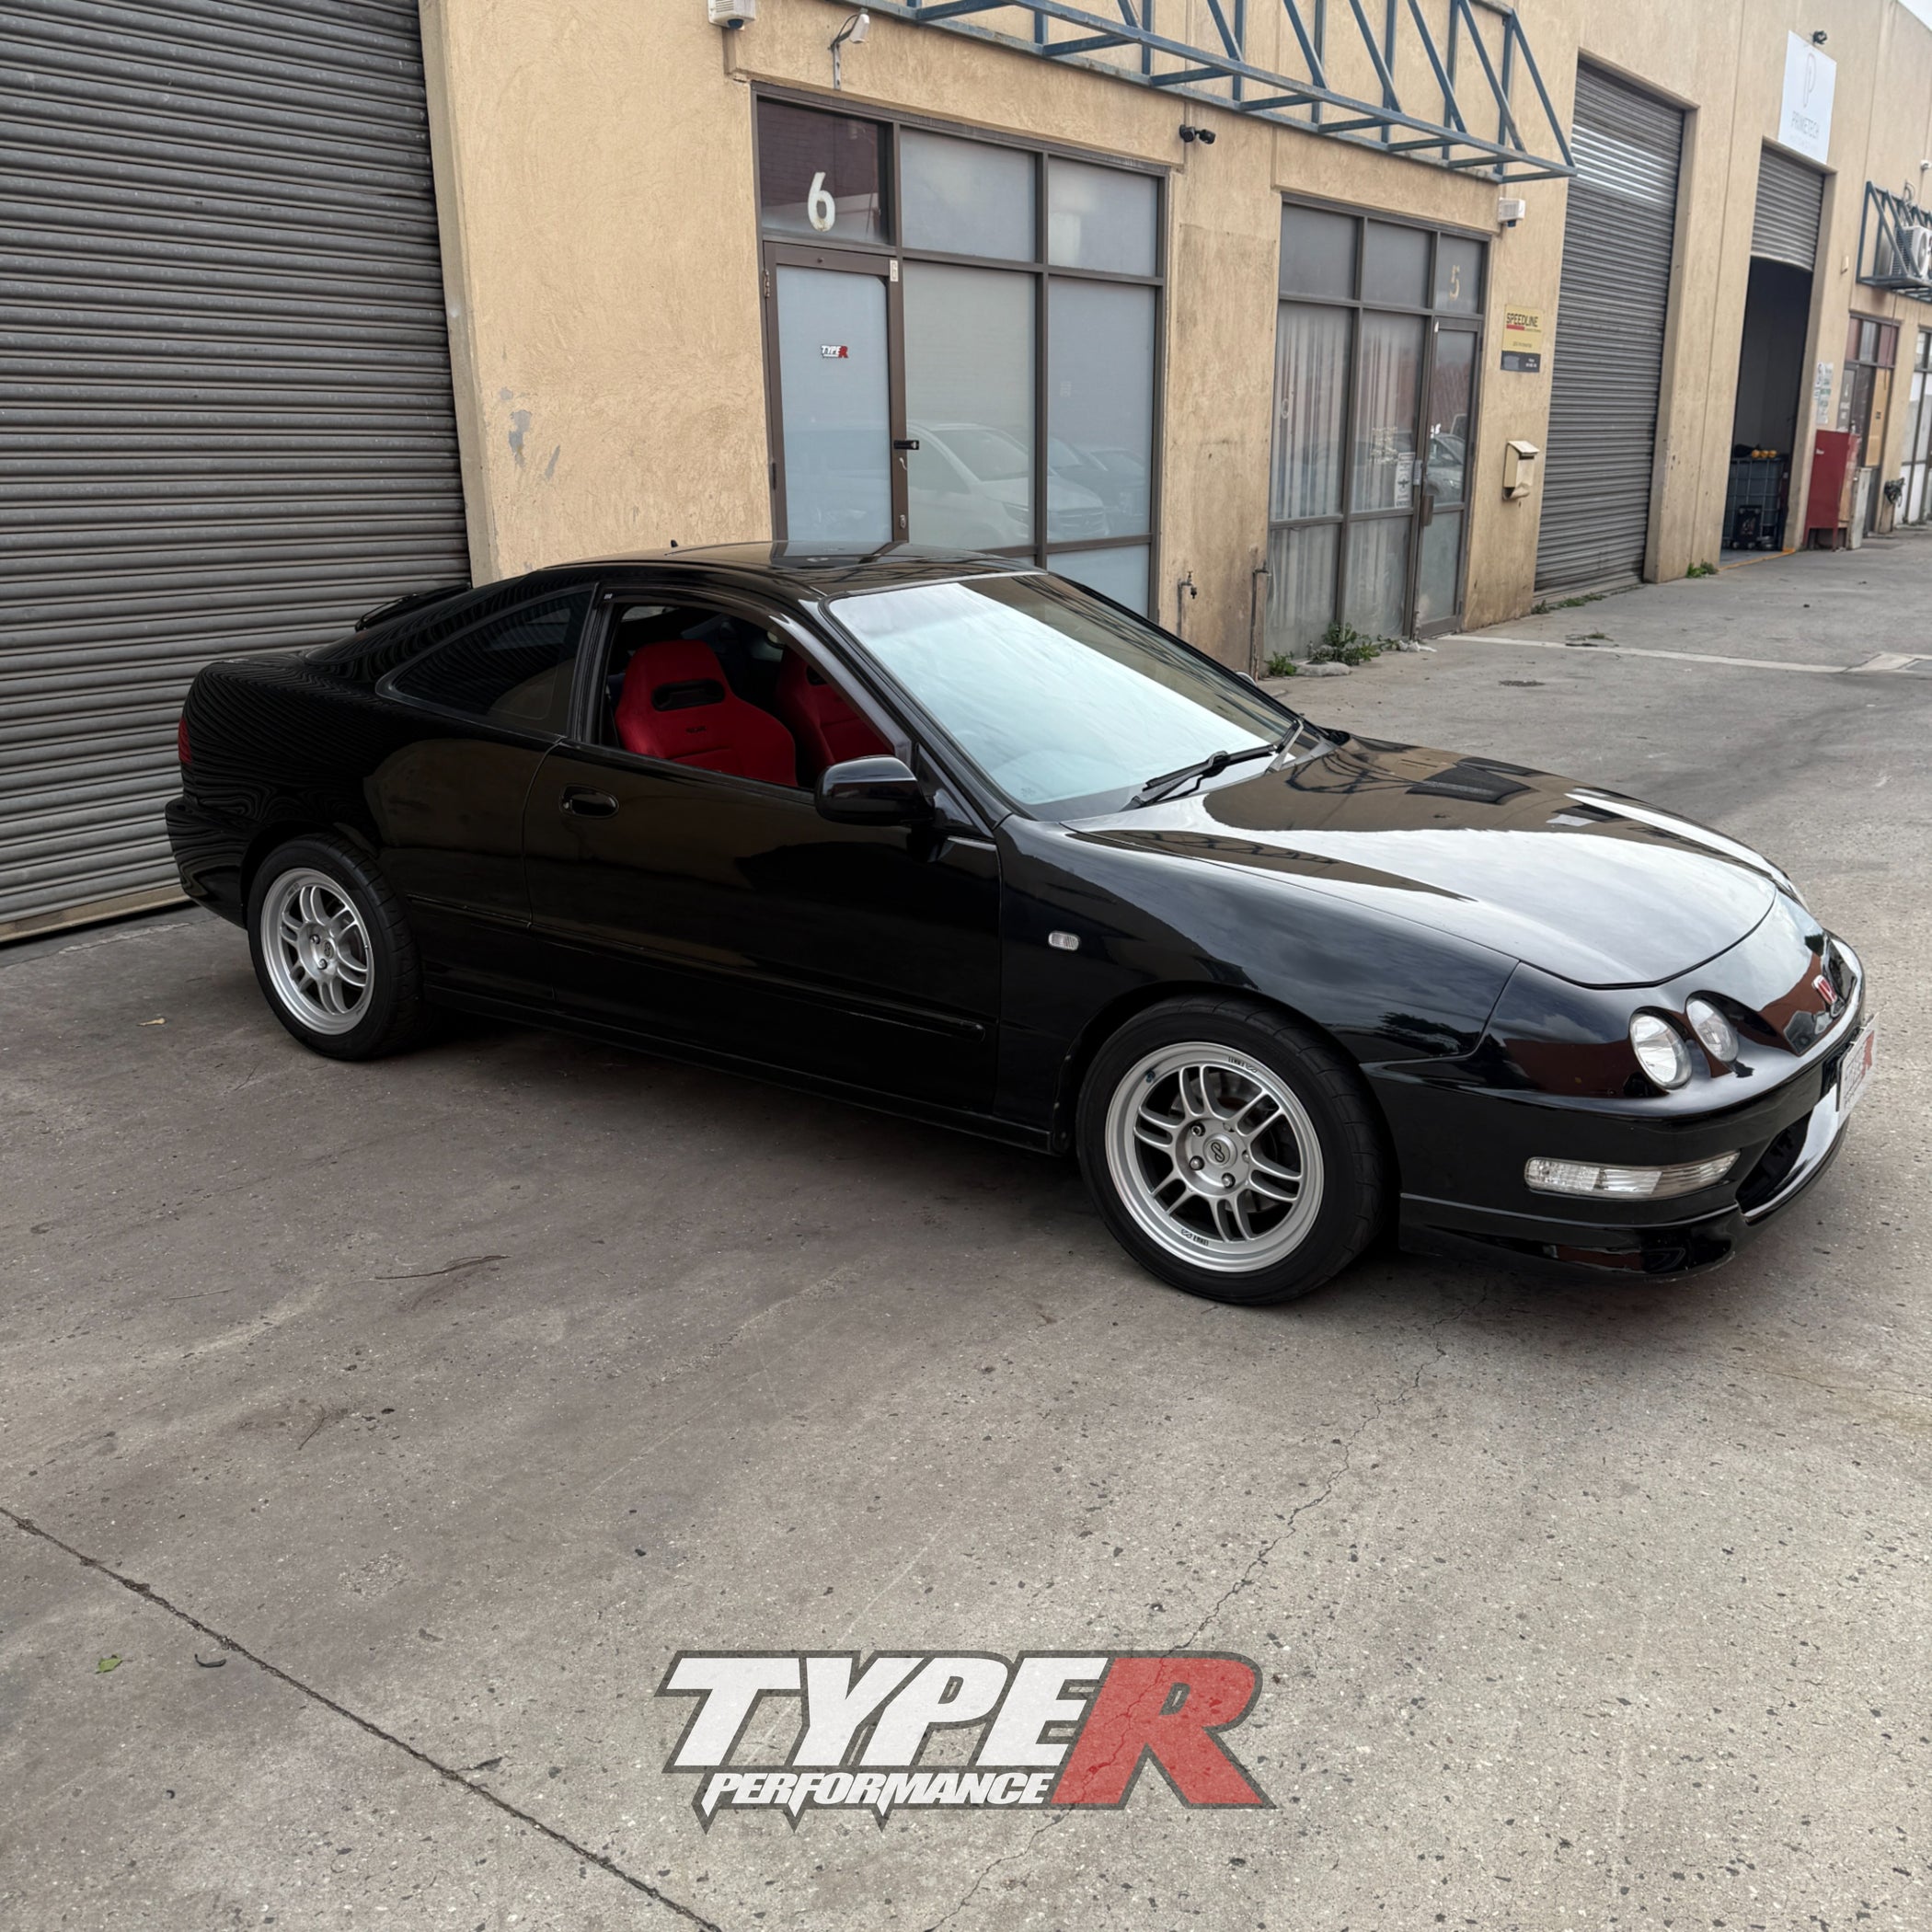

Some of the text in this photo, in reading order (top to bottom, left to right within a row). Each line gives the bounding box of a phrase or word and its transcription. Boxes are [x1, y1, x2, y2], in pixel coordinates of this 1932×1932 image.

[808, 171, 835, 232] 6
[891, 261, 898, 281] 6
[1449, 264, 1461, 302] 5
[1506, 313, 1539, 328] SPEEDLINE
